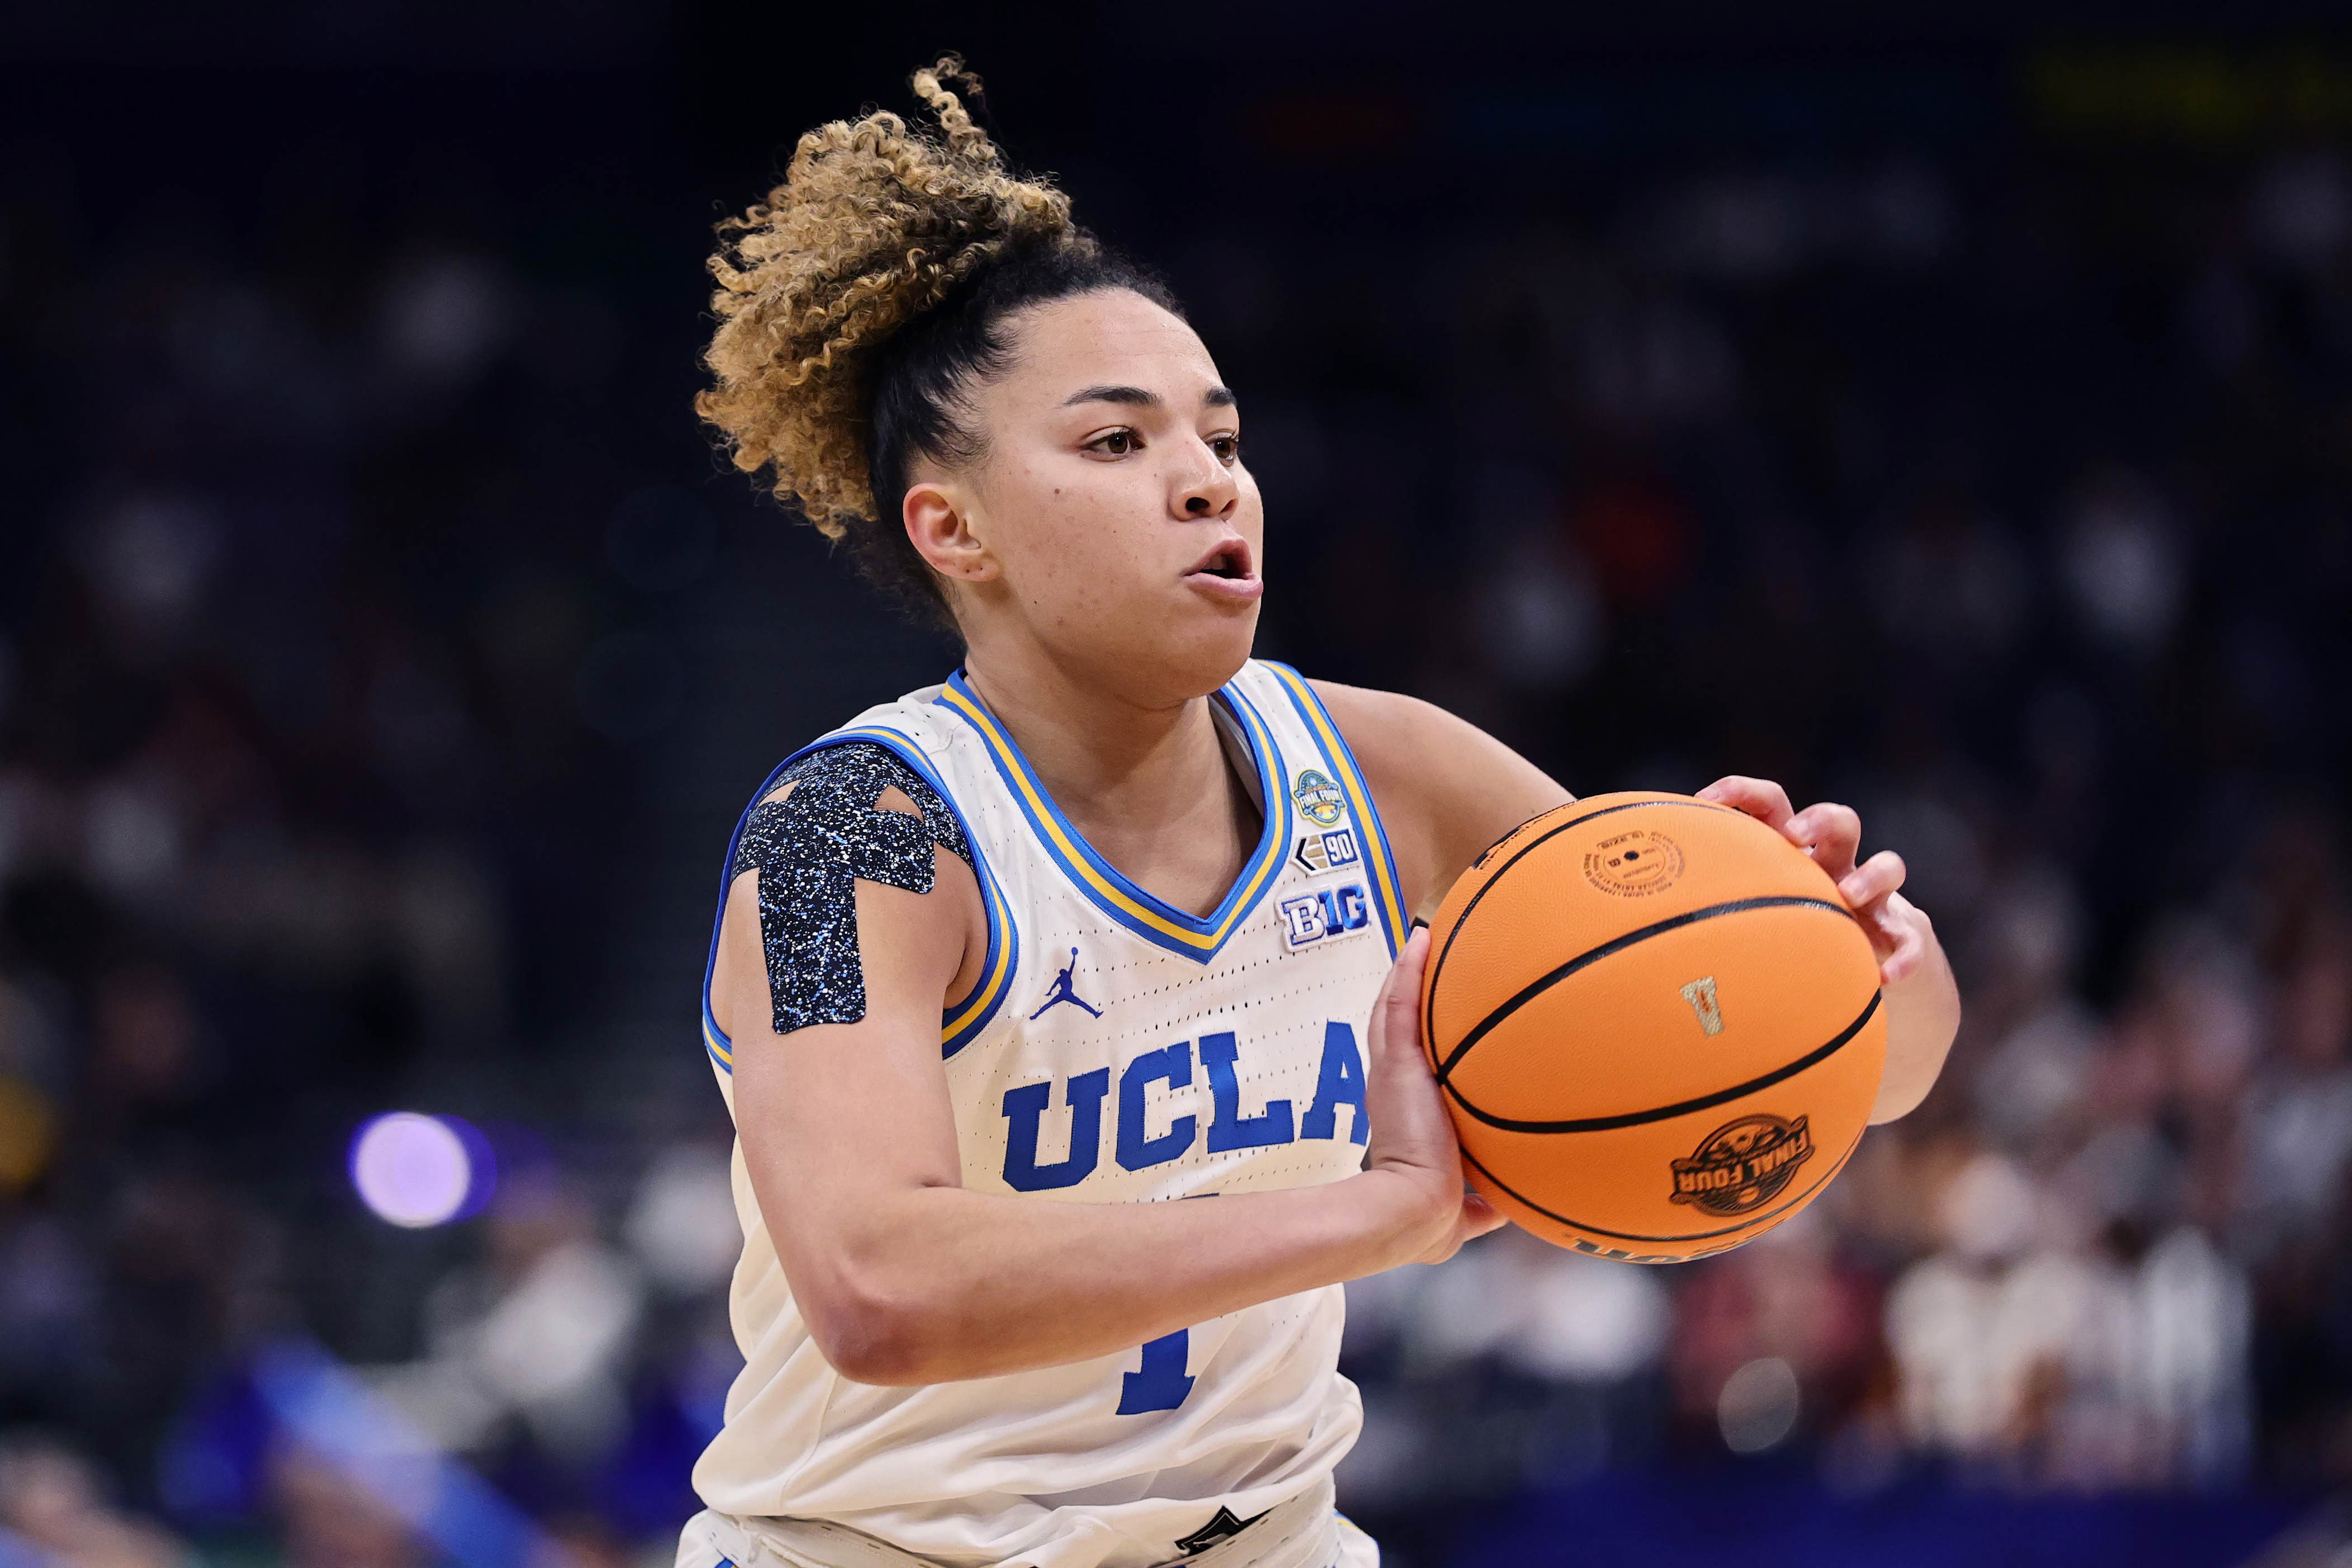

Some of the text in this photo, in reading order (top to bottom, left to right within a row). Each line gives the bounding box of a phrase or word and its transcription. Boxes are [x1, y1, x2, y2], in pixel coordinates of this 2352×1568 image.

[1299, 789, 1342, 809] FINAL FOUR
[1324, 833, 1354, 862] 90
[1002, 1021, 1370, 1192] UCLA
[1676, 1130, 1807, 1193] FINAL FOUR
